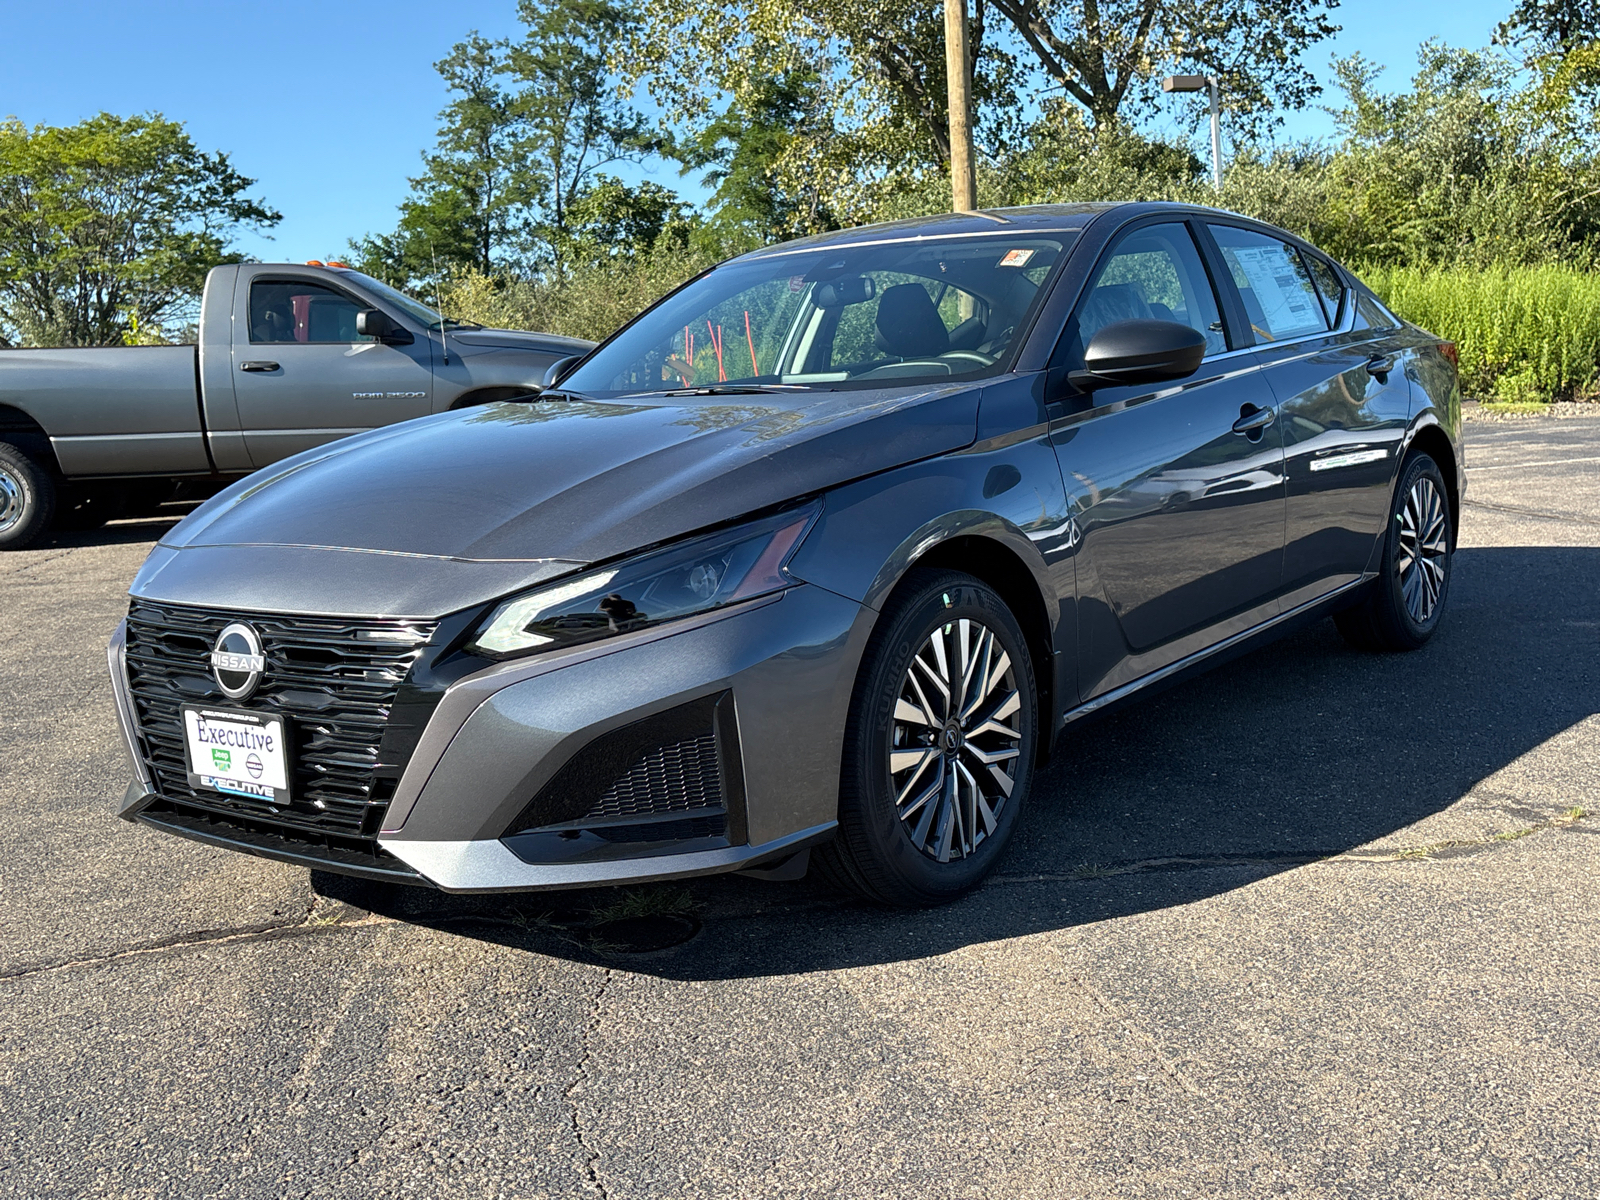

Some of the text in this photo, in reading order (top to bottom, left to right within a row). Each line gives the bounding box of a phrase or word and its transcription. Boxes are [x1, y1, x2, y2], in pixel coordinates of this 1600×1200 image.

[352, 391, 384, 400] RAM
[1402, 464, 1421, 501] KUMHO
[211, 652, 263, 670] NISSAN
[877, 640, 910, 731] KUMHO
[196, 718, 274, 753] Executive
[214, 750, 229, 761] Jeep
[200, 775, 275, 798] EXECUTIVE
